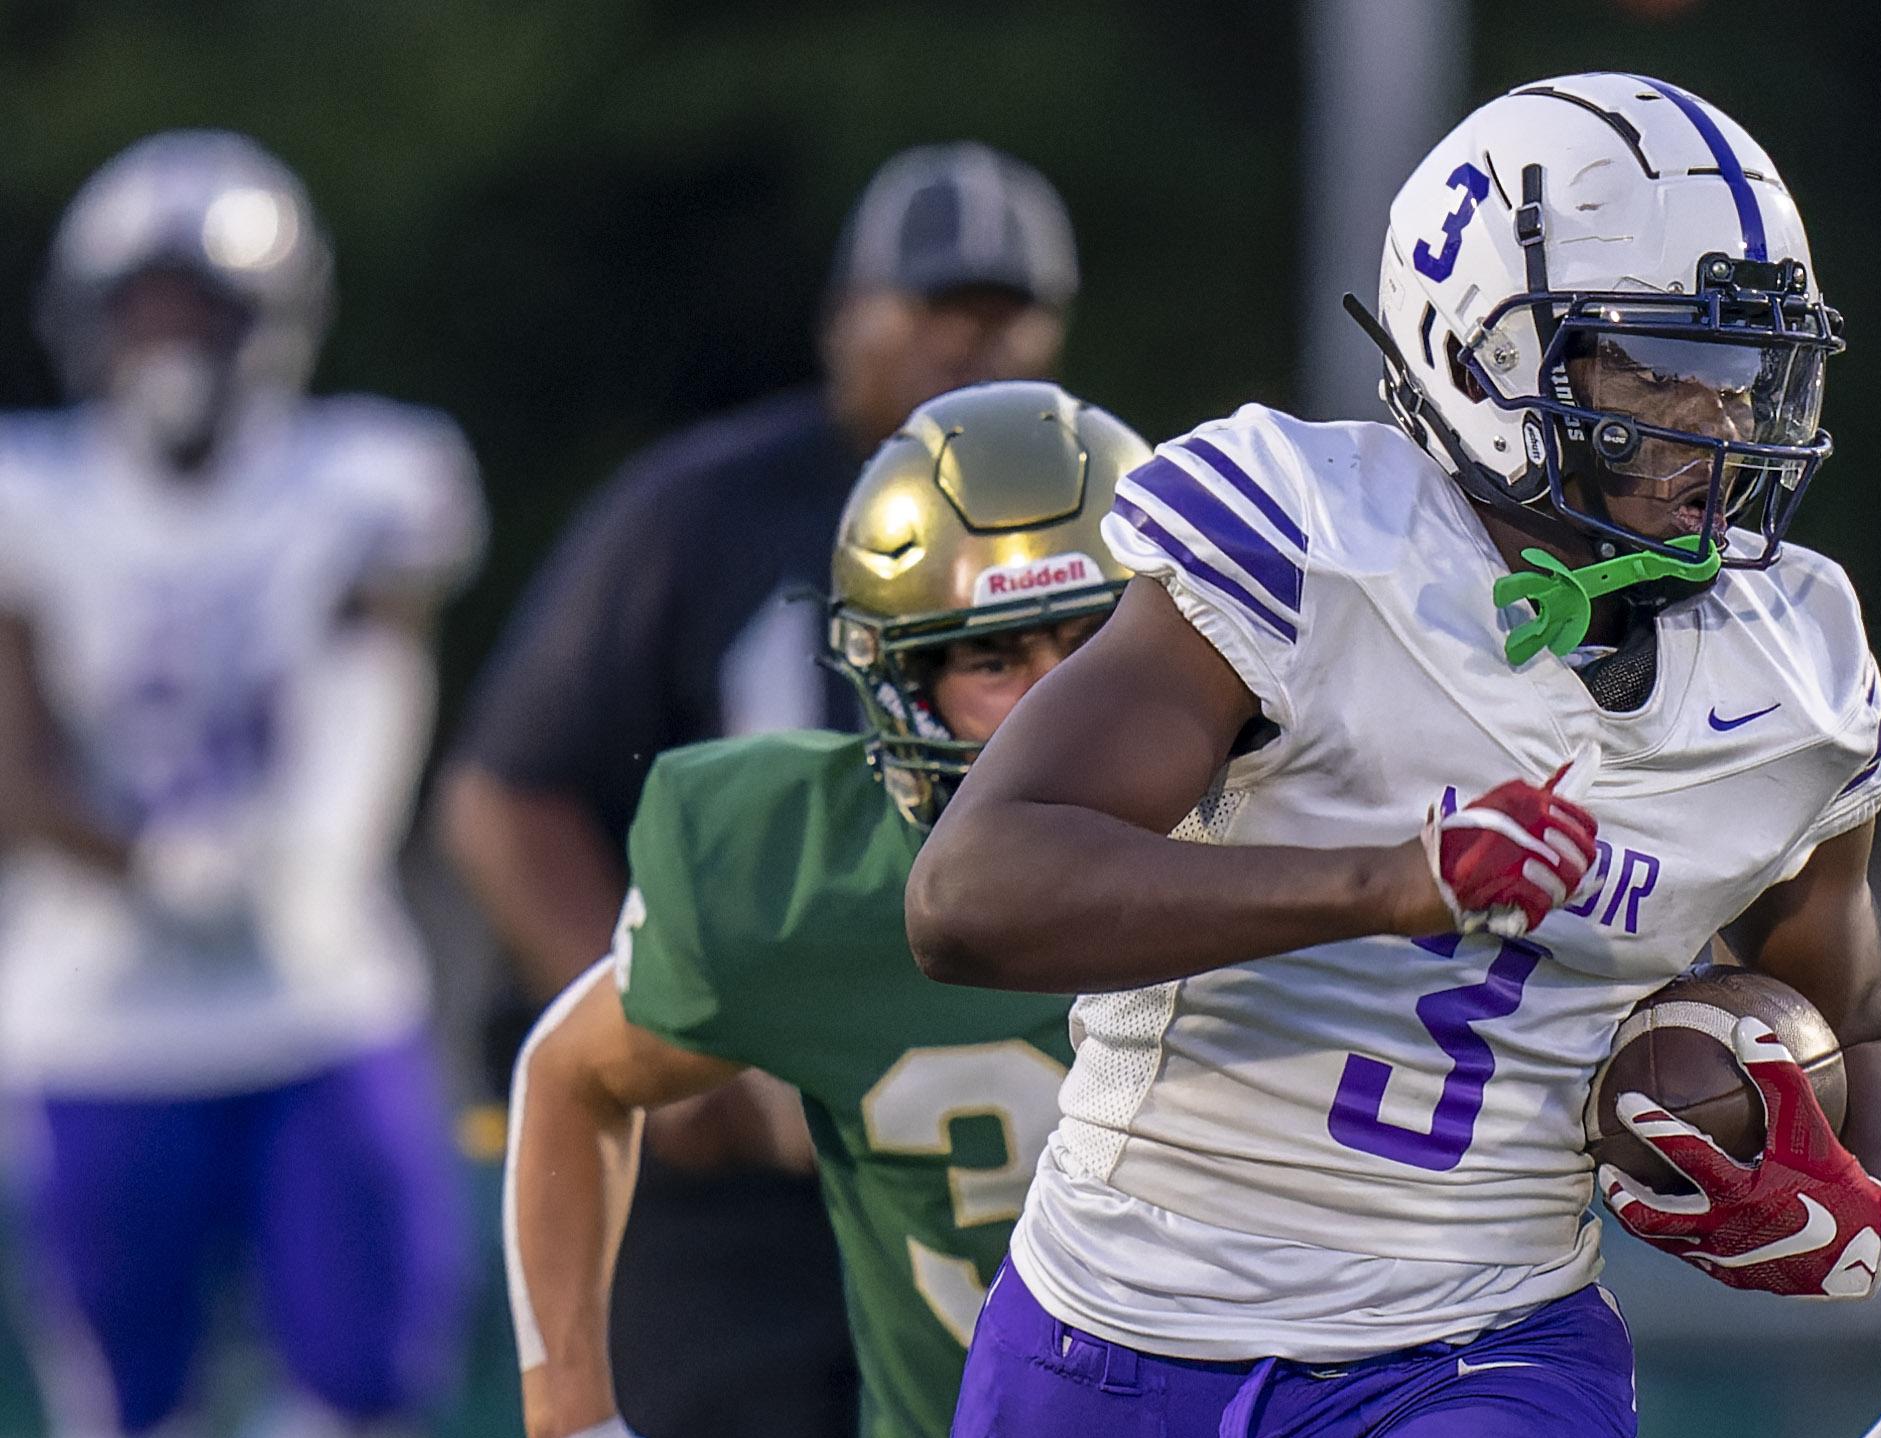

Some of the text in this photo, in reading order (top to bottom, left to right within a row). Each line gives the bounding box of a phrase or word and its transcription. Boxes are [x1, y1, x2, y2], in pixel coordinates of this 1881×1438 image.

[1412, 161, 1491, 284] 3
[988, 559, 1086, 595] Riddell
[1327, 931, 1554, 1172] 3
